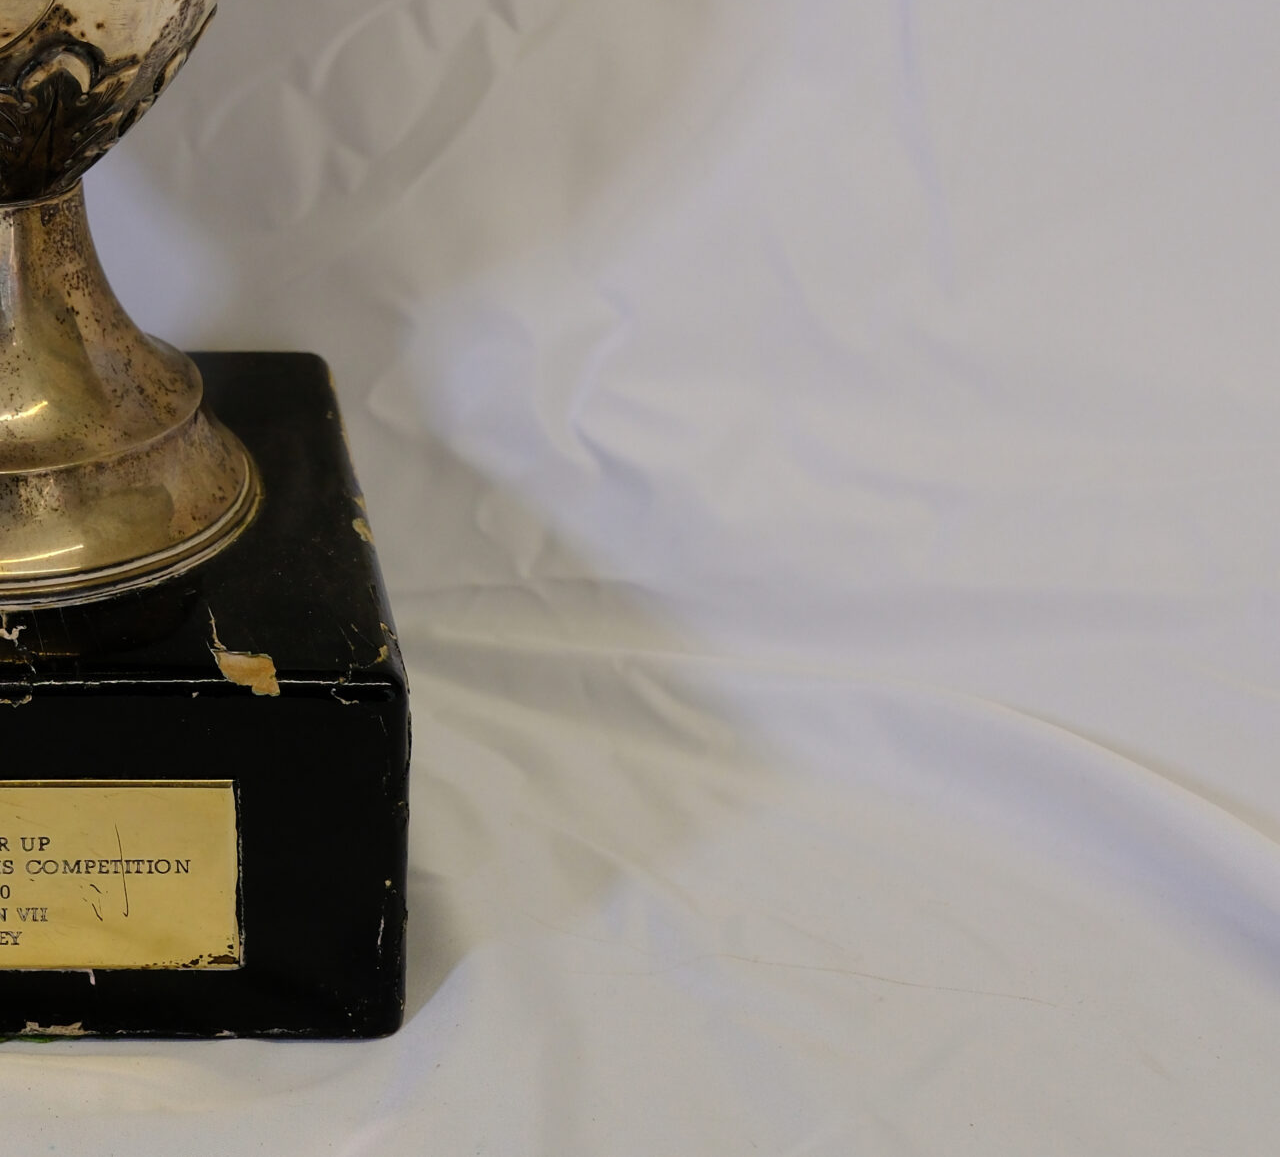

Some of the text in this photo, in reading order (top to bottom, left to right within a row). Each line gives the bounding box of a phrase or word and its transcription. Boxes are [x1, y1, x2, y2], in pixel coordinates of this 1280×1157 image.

[20, 836, 51, 853] UP
[25, 859, 191, 875] COMPETITION
[16, 907, 49, 923] VII
